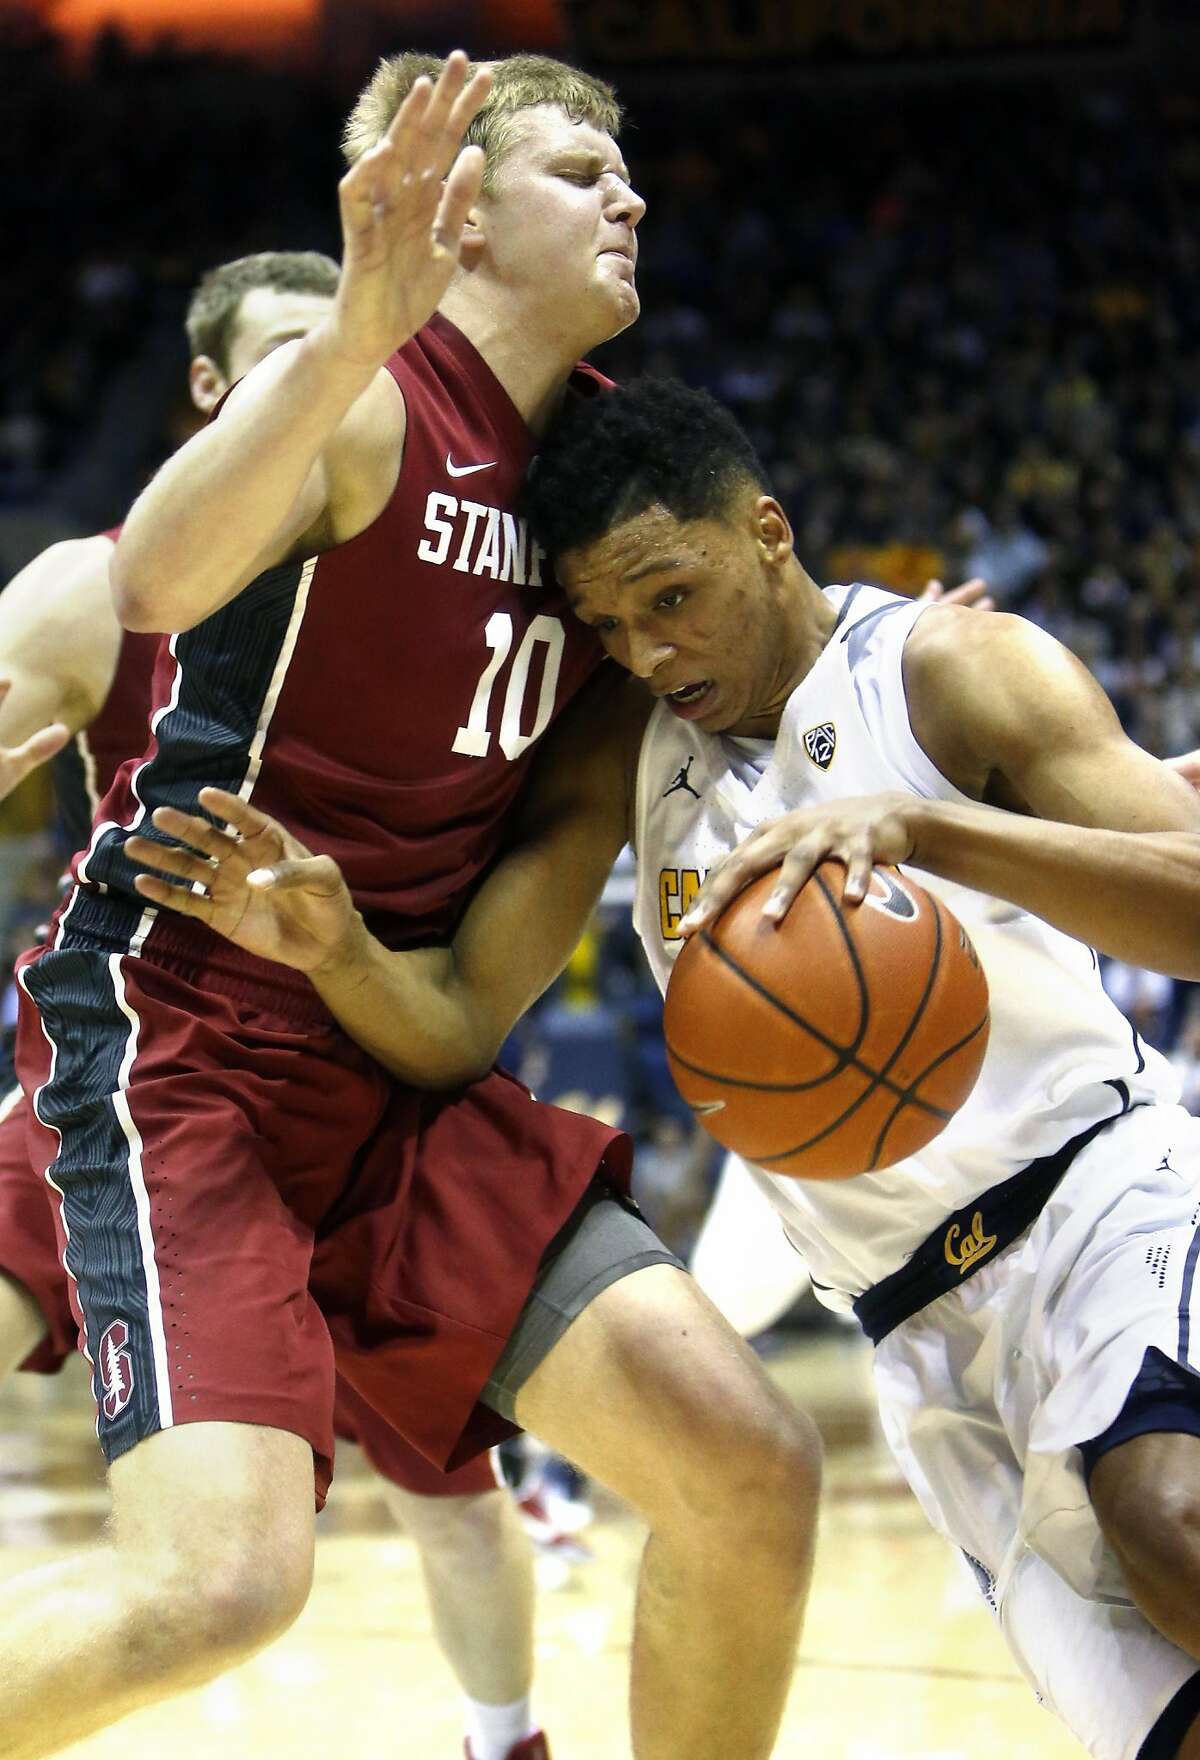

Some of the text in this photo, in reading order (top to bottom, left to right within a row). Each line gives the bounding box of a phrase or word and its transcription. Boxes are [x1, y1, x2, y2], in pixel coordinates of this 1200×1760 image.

[417, 491, 547, 587] STANF
[451, 612, 565, 760] 10
[944, 1211, 997, 1274] Cal
